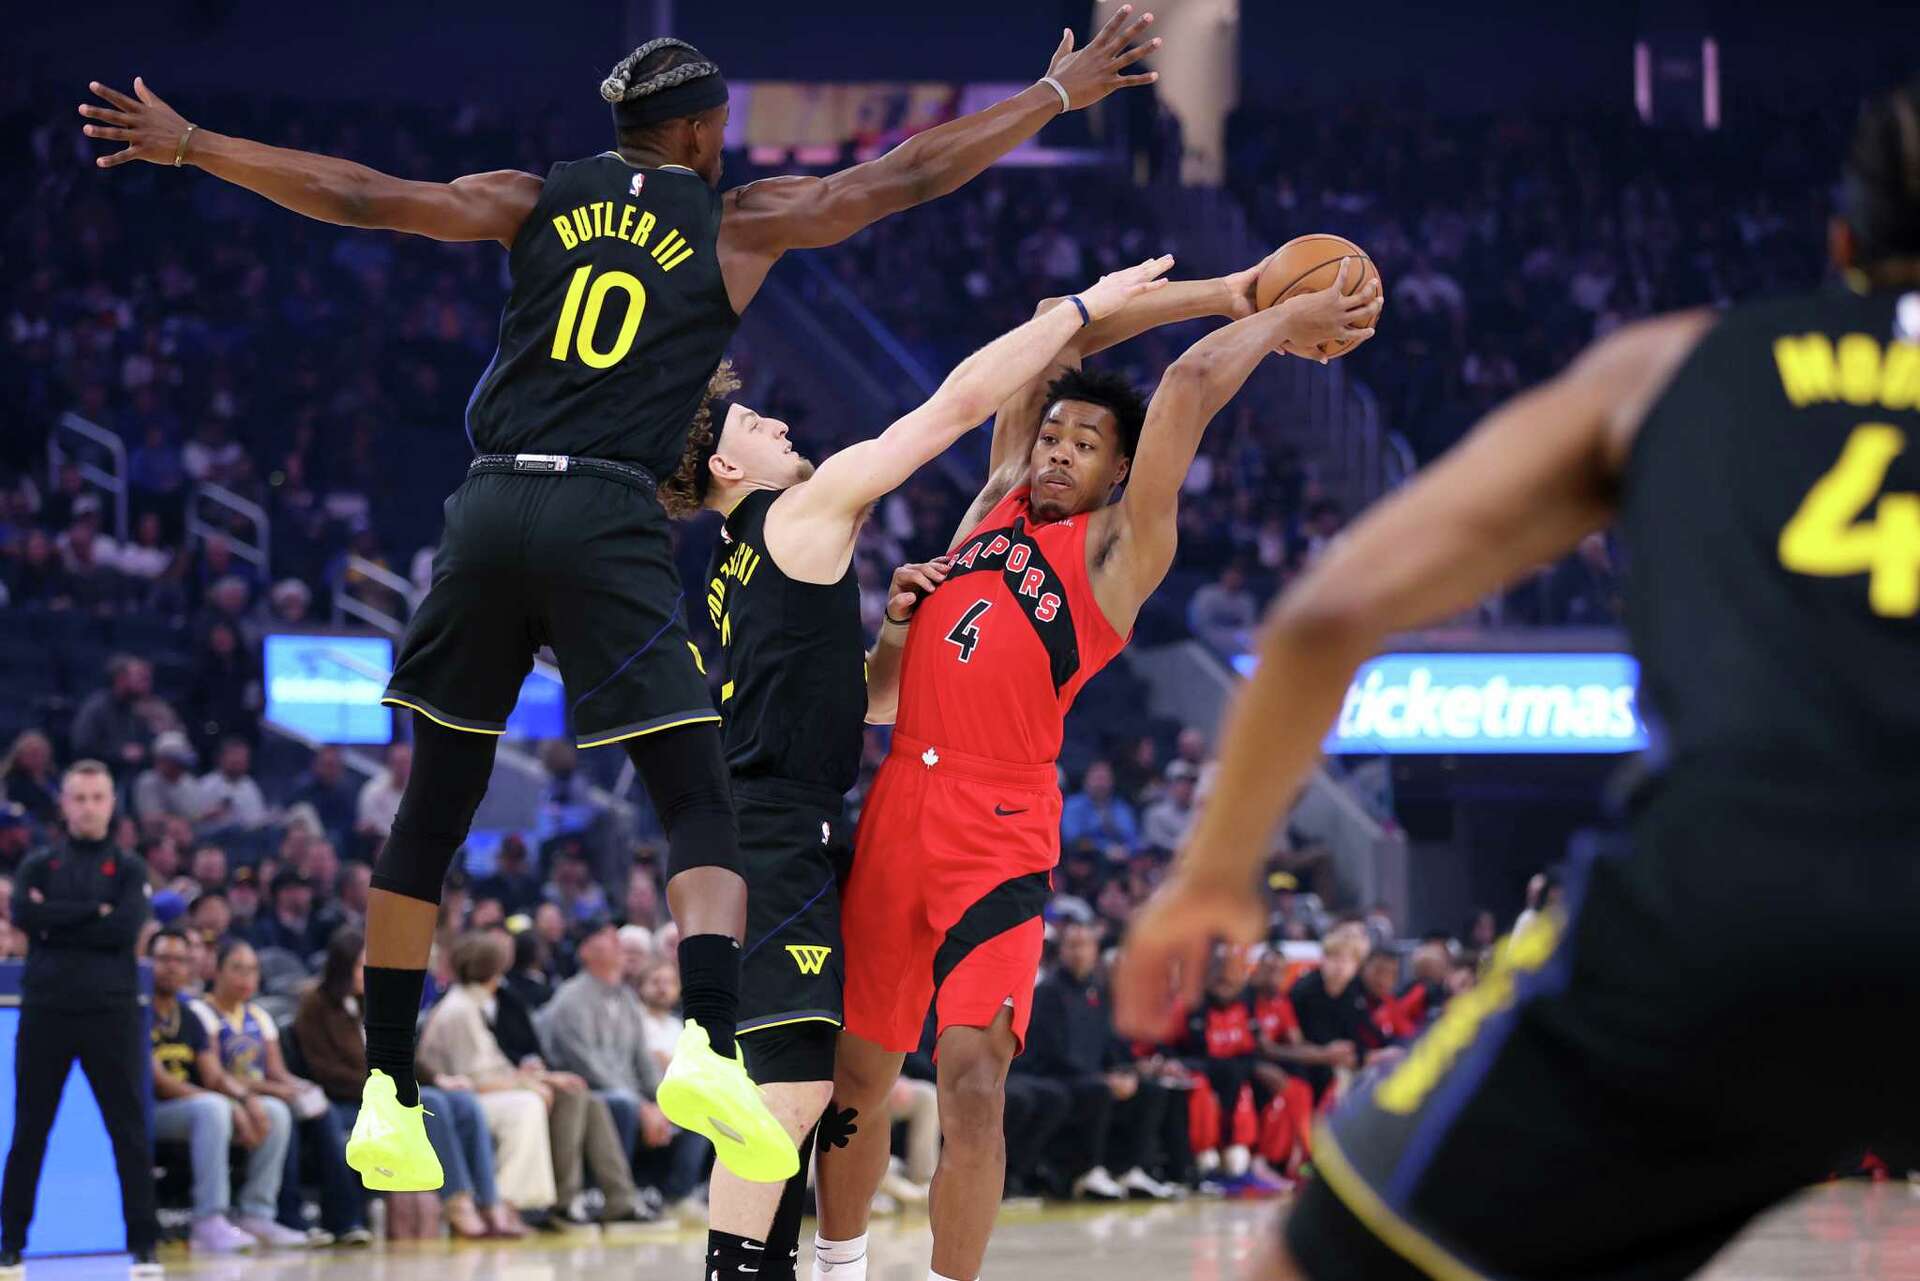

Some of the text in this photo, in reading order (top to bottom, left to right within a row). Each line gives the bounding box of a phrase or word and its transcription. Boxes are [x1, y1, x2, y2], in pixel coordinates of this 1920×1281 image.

[552, 201, 695, 272] BUTLER III
[550, 263, 647, 369] 10
[1768, 421, 1920, 618] 4
[944, 598, 993, 664] 4
